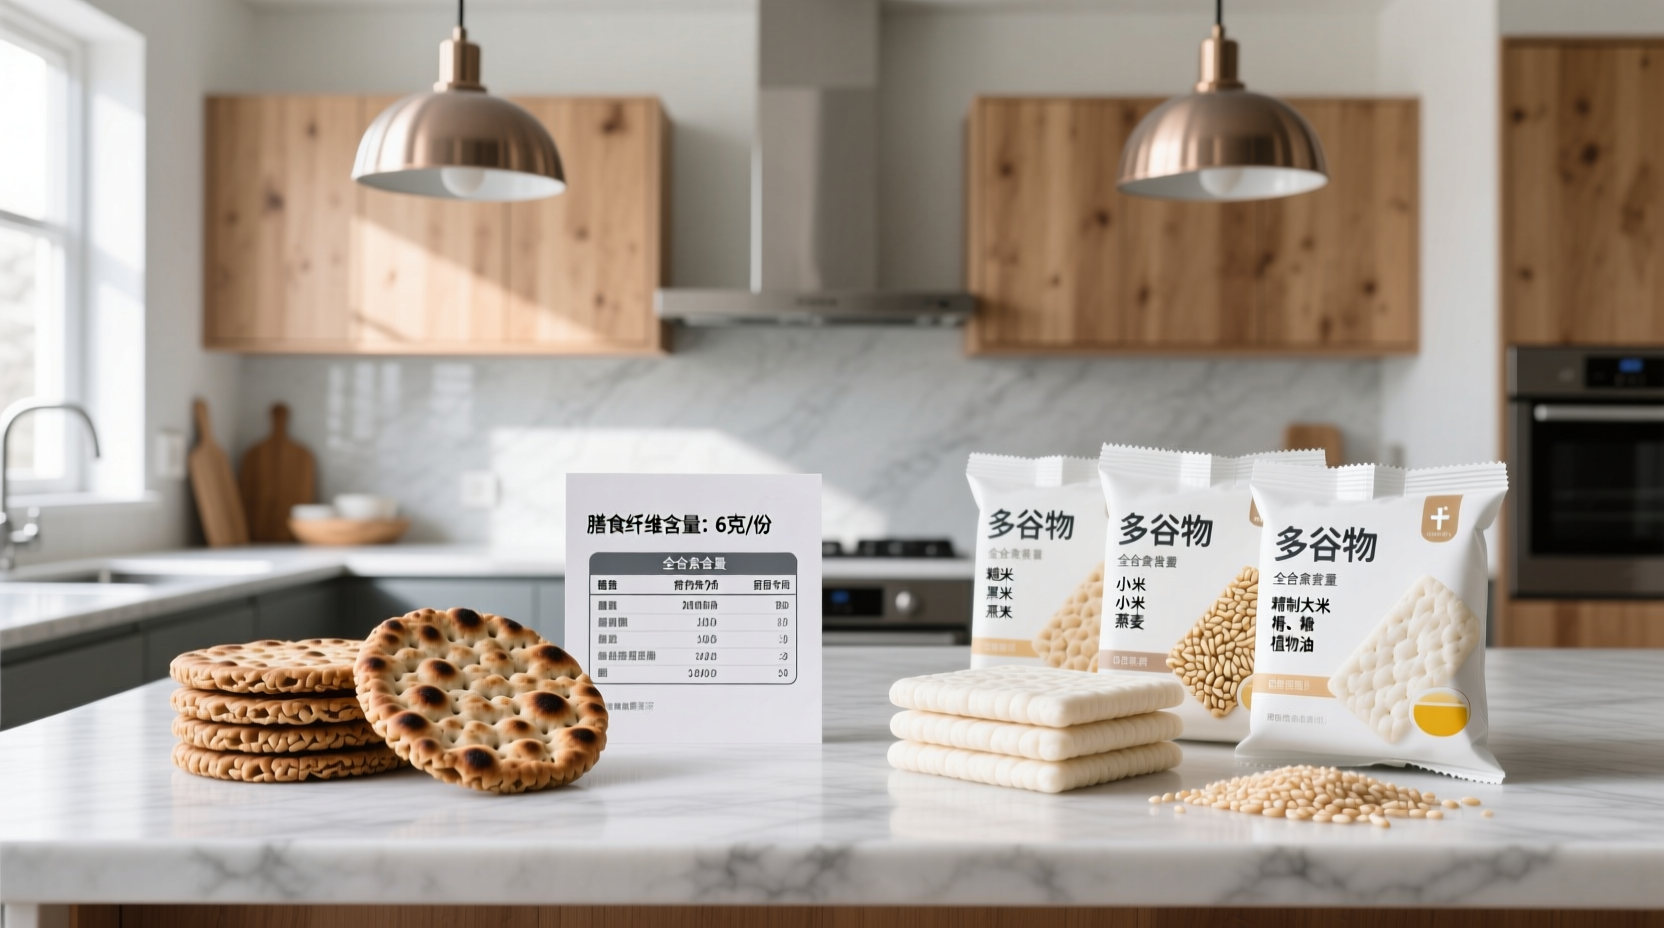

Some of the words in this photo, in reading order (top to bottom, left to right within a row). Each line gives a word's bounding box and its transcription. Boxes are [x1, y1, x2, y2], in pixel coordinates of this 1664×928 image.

[987, 508, 1075, 540] 多谷物
[1118, 512, 1214, 548] 多谷物
[1274, 526, 1378, 563] 多谷物
[1116, 576, 1147, 593] 小米
[1115, 595, 1146, 612] 小米
[1270, 635, 1315, 653] 植物油
